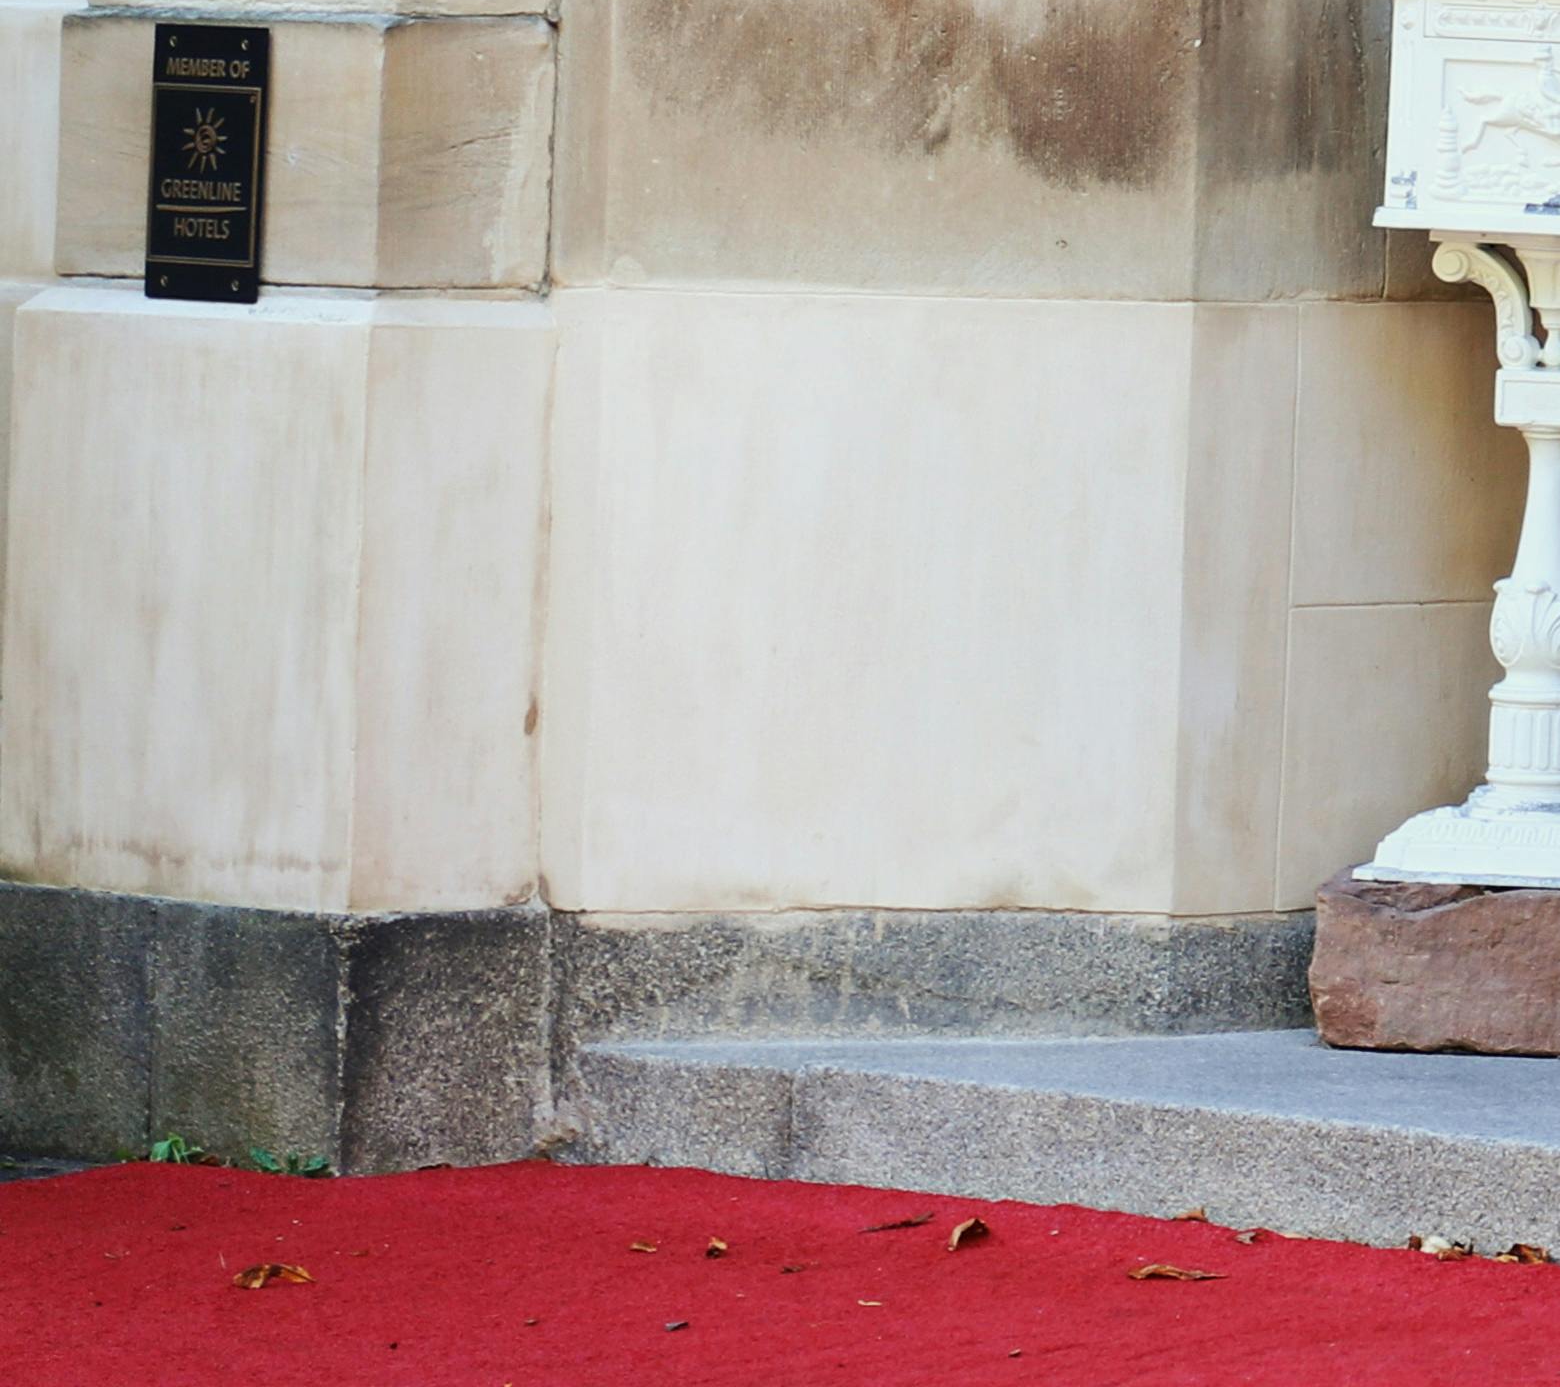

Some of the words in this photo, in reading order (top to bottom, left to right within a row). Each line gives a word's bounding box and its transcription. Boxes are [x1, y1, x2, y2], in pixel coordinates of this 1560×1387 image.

[166, 56, 226, 78] MEMBER
[229, 59, 250, 79] OF
[160, 178, 242, 203] GREENLINE
[173, 216, 231, 240] HOTELS
